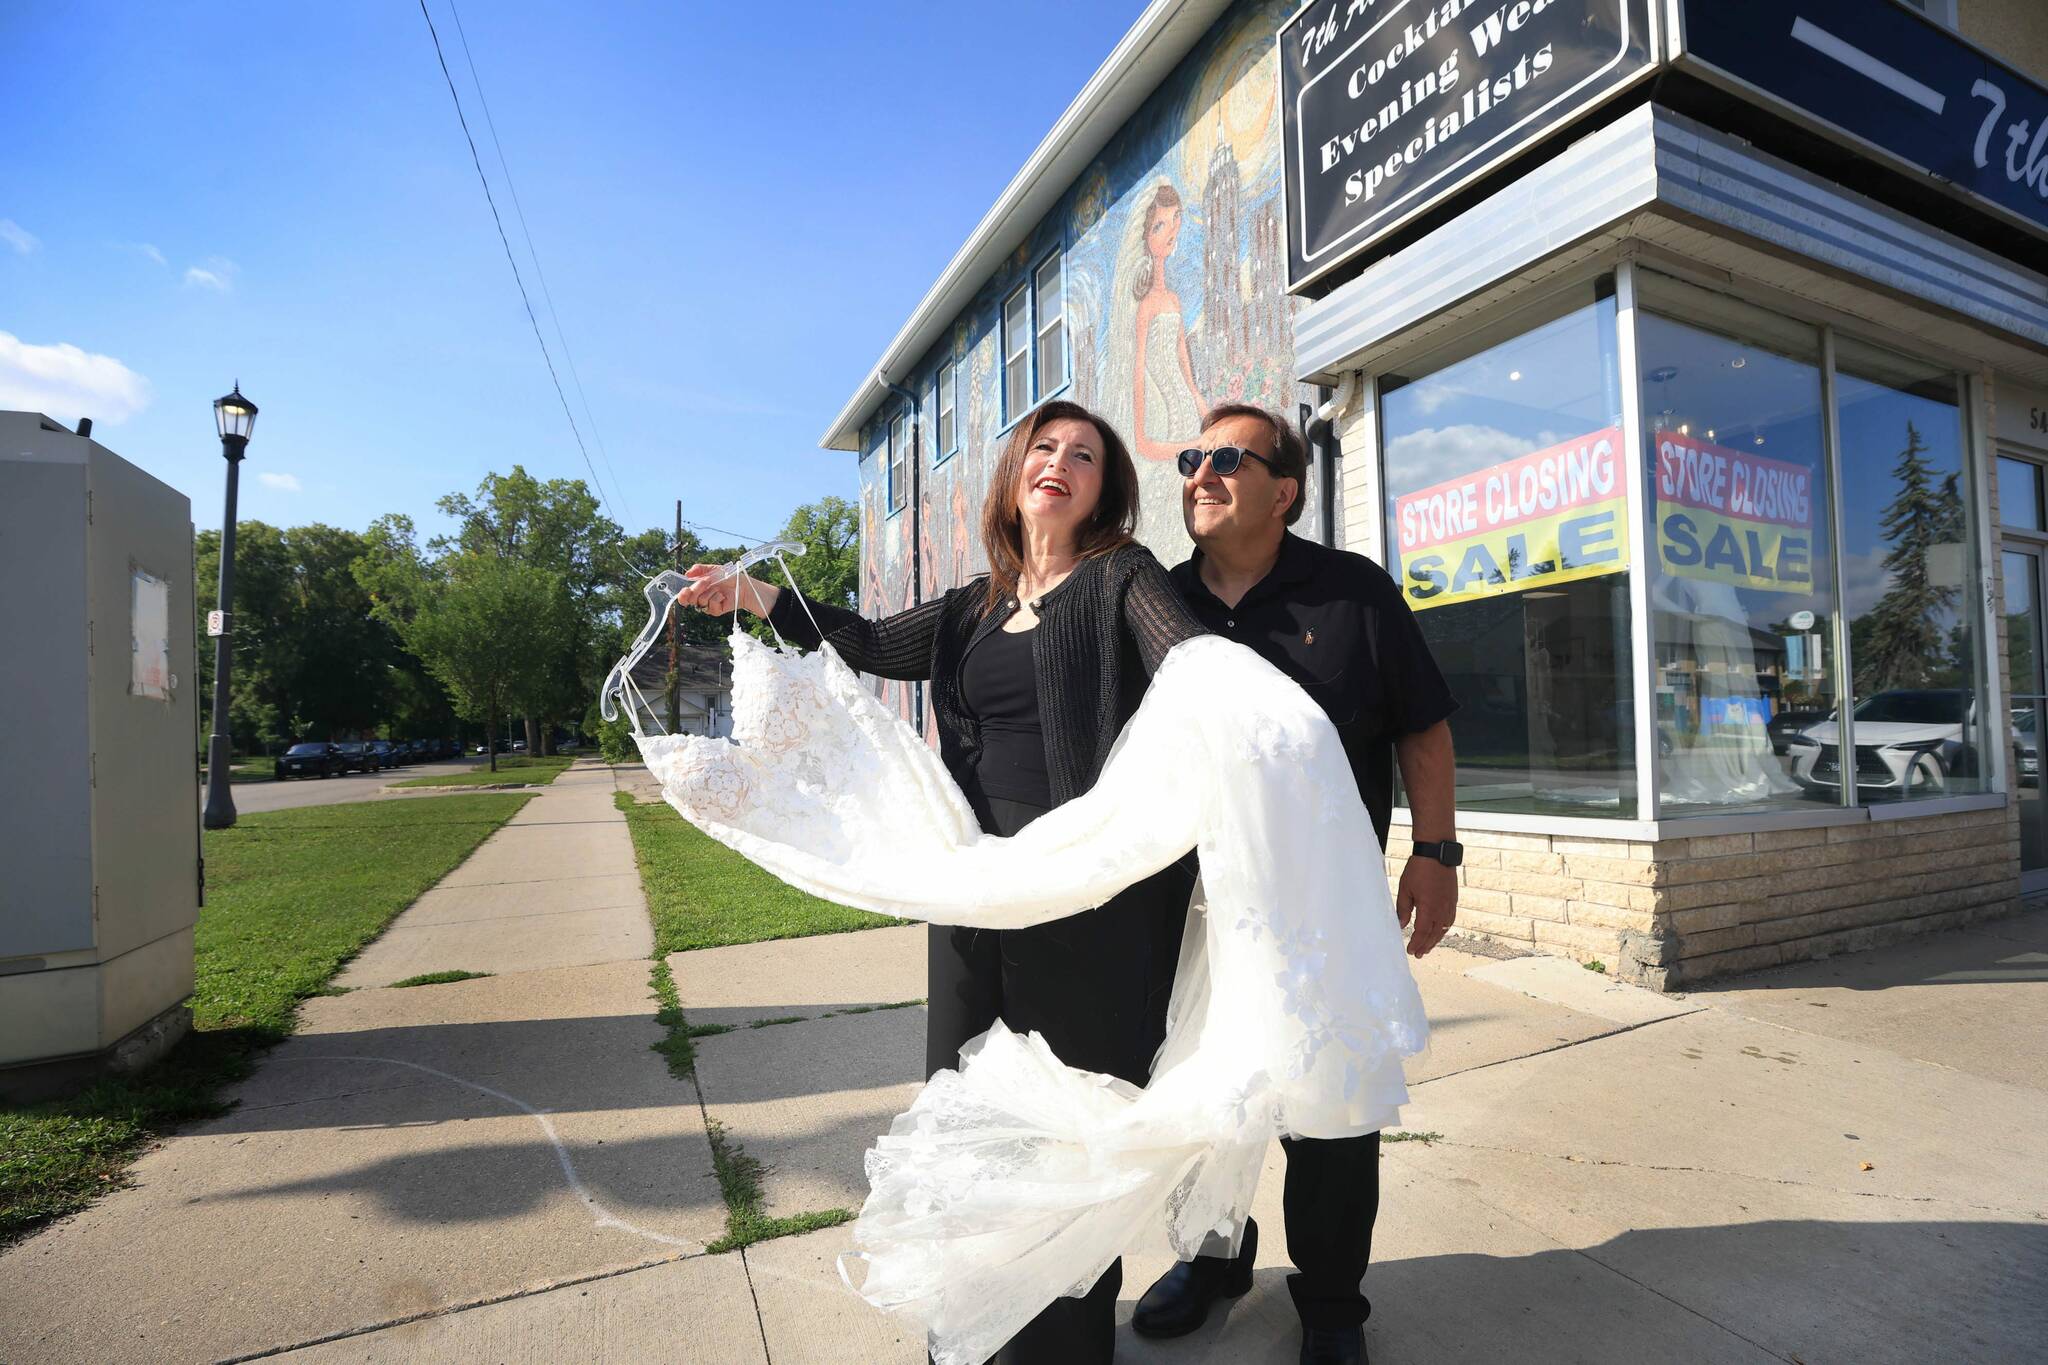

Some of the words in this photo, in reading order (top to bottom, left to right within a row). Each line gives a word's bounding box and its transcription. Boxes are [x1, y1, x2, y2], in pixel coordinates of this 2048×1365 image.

[1302, 3, 1339, 67] 7th
[1321, 48, 1460, 174] Evening
[1345, 42, 1553, 208] Specialists
[1403, 483, 1478, 546] STORE
[1485, 439, 1615, 524] CLOSING
[1661, 441, 1727, 509] STORE
[1731, 460, 1809, 523] CLOSING
[1408, 510, 1619, 599] SALE
[1663, 513, 1811, 583] SALE
